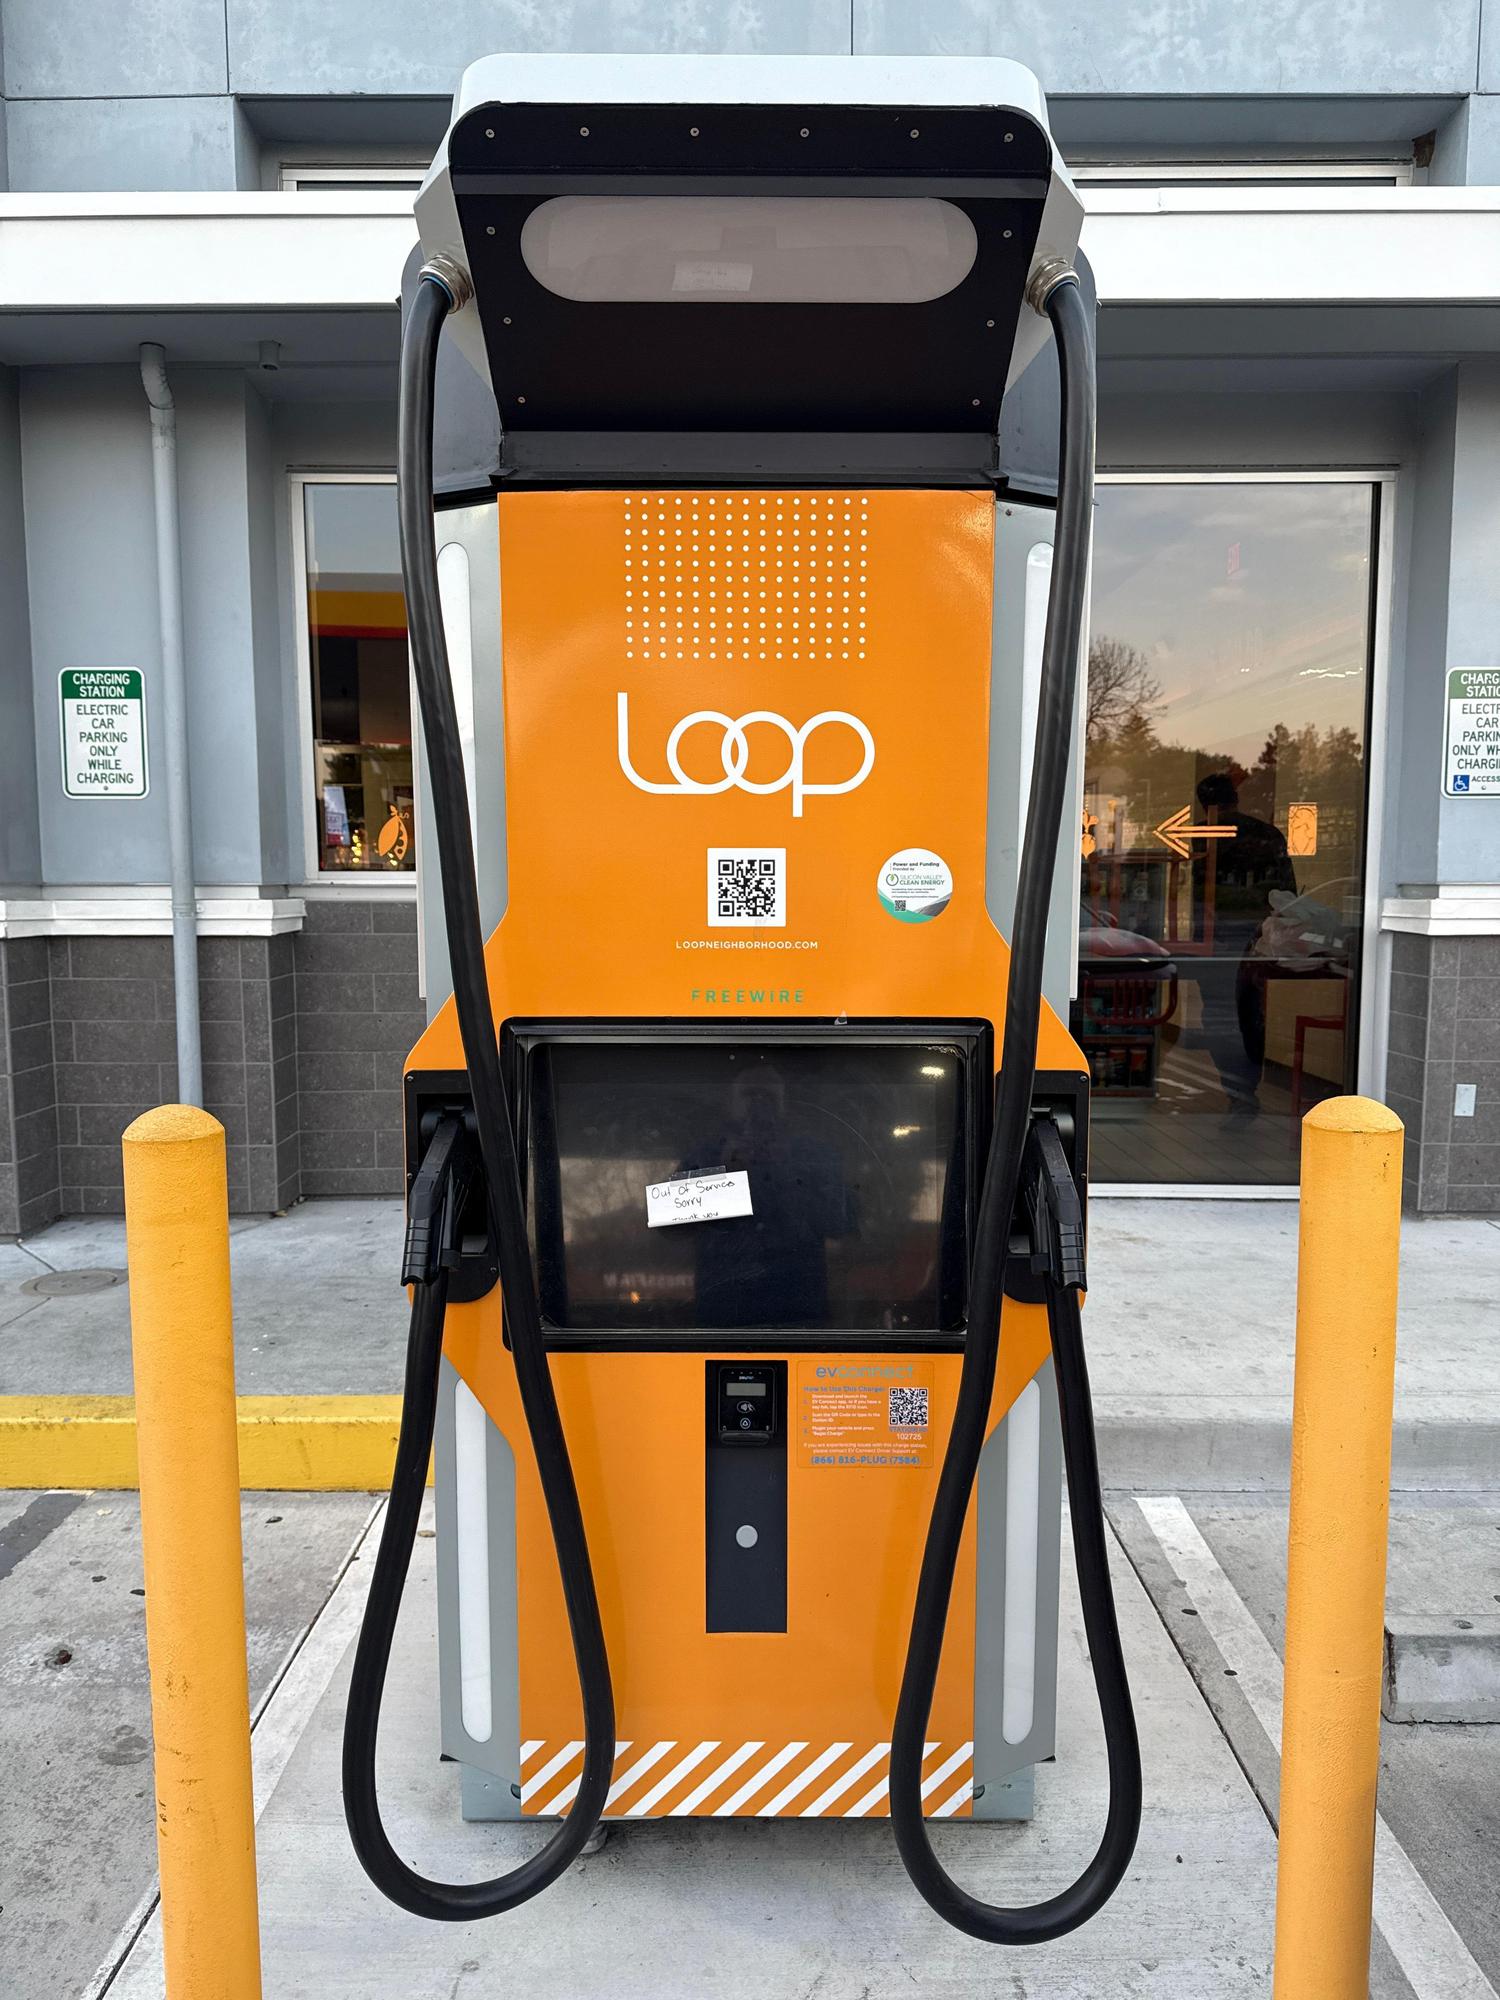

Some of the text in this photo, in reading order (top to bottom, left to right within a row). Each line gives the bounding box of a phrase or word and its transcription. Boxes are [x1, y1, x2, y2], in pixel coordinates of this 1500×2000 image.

[72, 673, 130, 684] CHARGING
[80, 686, 125, 697] STATION
[76, 704, 128, 715] ELECTRIC
[92, 718, 115, 729] CAR
[1476, 717, 1499, 728] CAR
[79, 732, 128, 743] PARKING
[90, 745, 118, 756] ONLY
[1453, 745, 1481, 756] ONLY
[88, 759, 122, 770] WHILE
[77, 773, 134, 784] CHARGING
[676, 941, 818, 949] LOOPNEIGHBORHOOD.COM
[691, 990, 805, 1003] FREEWIRE
[651, 1186, 670, 1199] Out
[674, 1197, 702, 1208] Sorry
